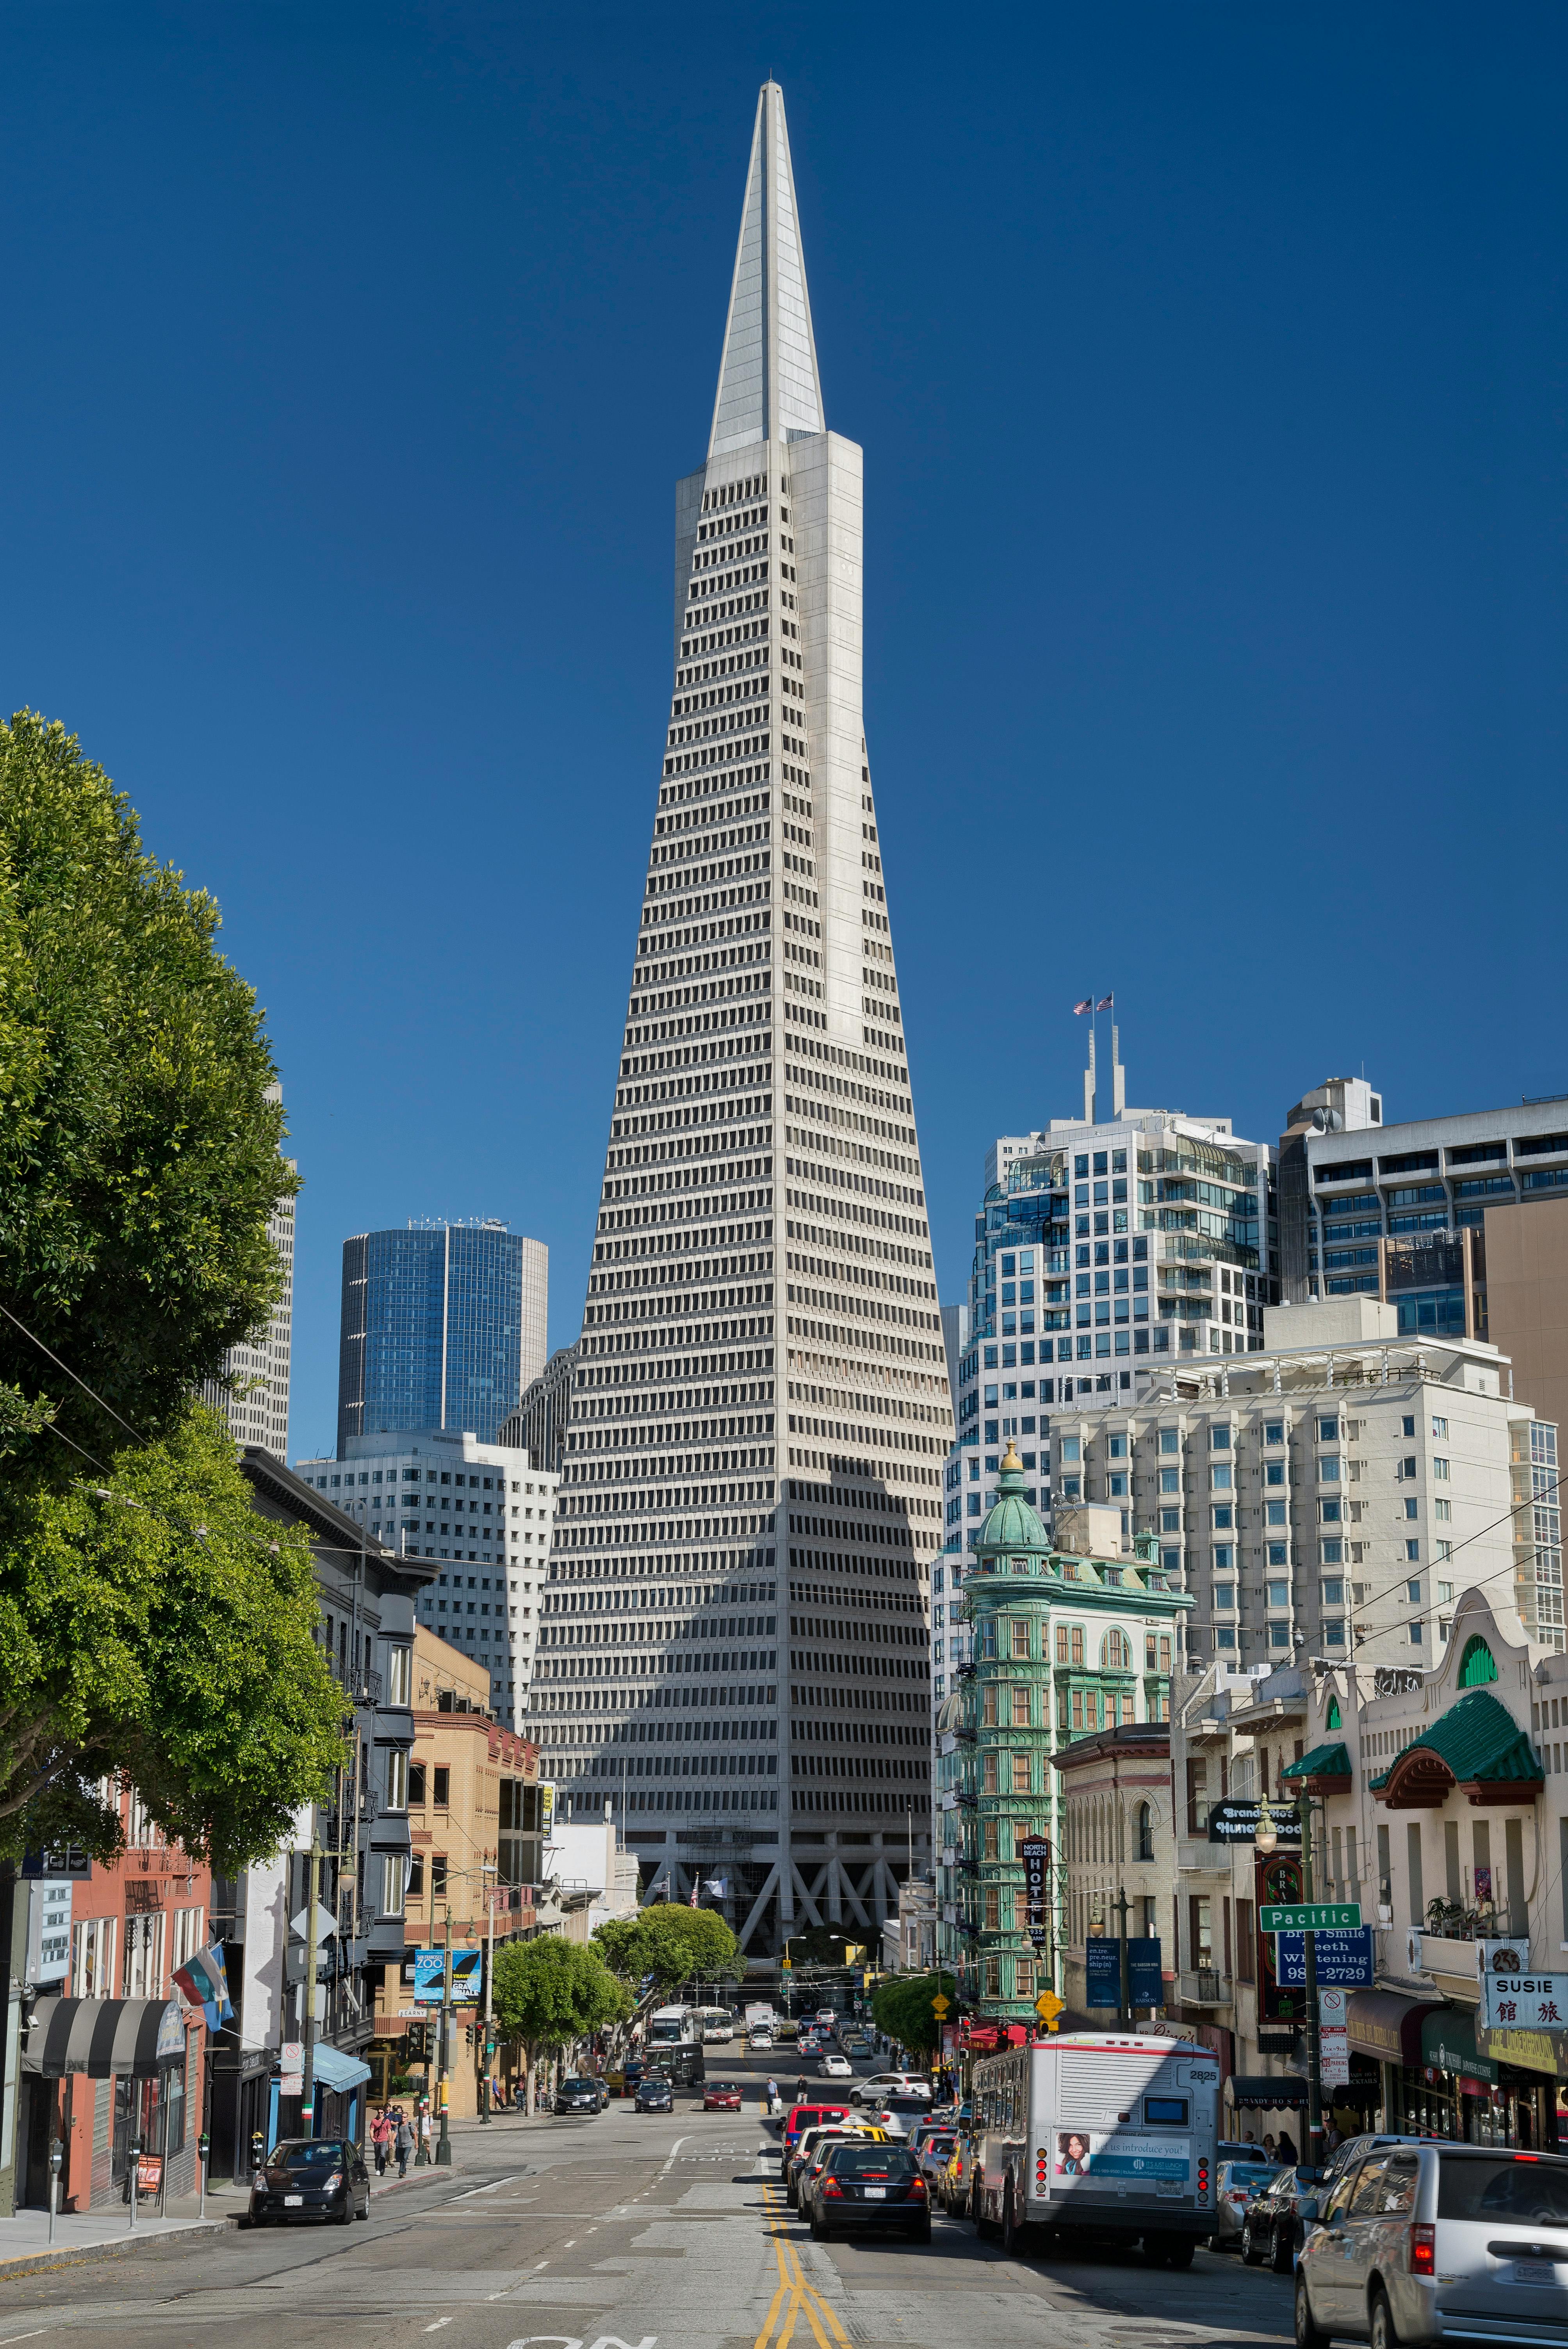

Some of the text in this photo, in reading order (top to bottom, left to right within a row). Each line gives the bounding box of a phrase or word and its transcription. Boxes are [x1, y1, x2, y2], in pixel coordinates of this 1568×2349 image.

[1223, 1808, 1262, 1818] Brand
[1215, 1821, 1256, 1834] Huna
[1030, 1859, 1041, 1926] HOTEL
[1272, 1910, 1349, 1925] Pacific
[1326, 1929, 1365, 1938] Smile
[1302, 1942, 1350, 1951] eeth
[416, 1959, 443, 1968] ZOO
[1283, 1953, 1368, 1965] Whtening
[1493, 1952, 1520, 1972] 233
[1288, 1968, 1365, 1980] 98-2729
[1497, 1980, 1552, 1993] SUSIE
[1495, 2000, 1562, 2022] 館 旅
[1506, 2029, 1554, 2059] UNDERGROUND
[1463, 2060, 1477, 2074] JAPANESE
[1477, 2065, 1491, 2077] CUISINE
[1190, 2071, 1217, 2080] 2825
[1096, 2141, 1108, 2150] Let
[1123, 2143, 1162, 2153] introduce
[1164, 2146, 1183, 2156] you!
